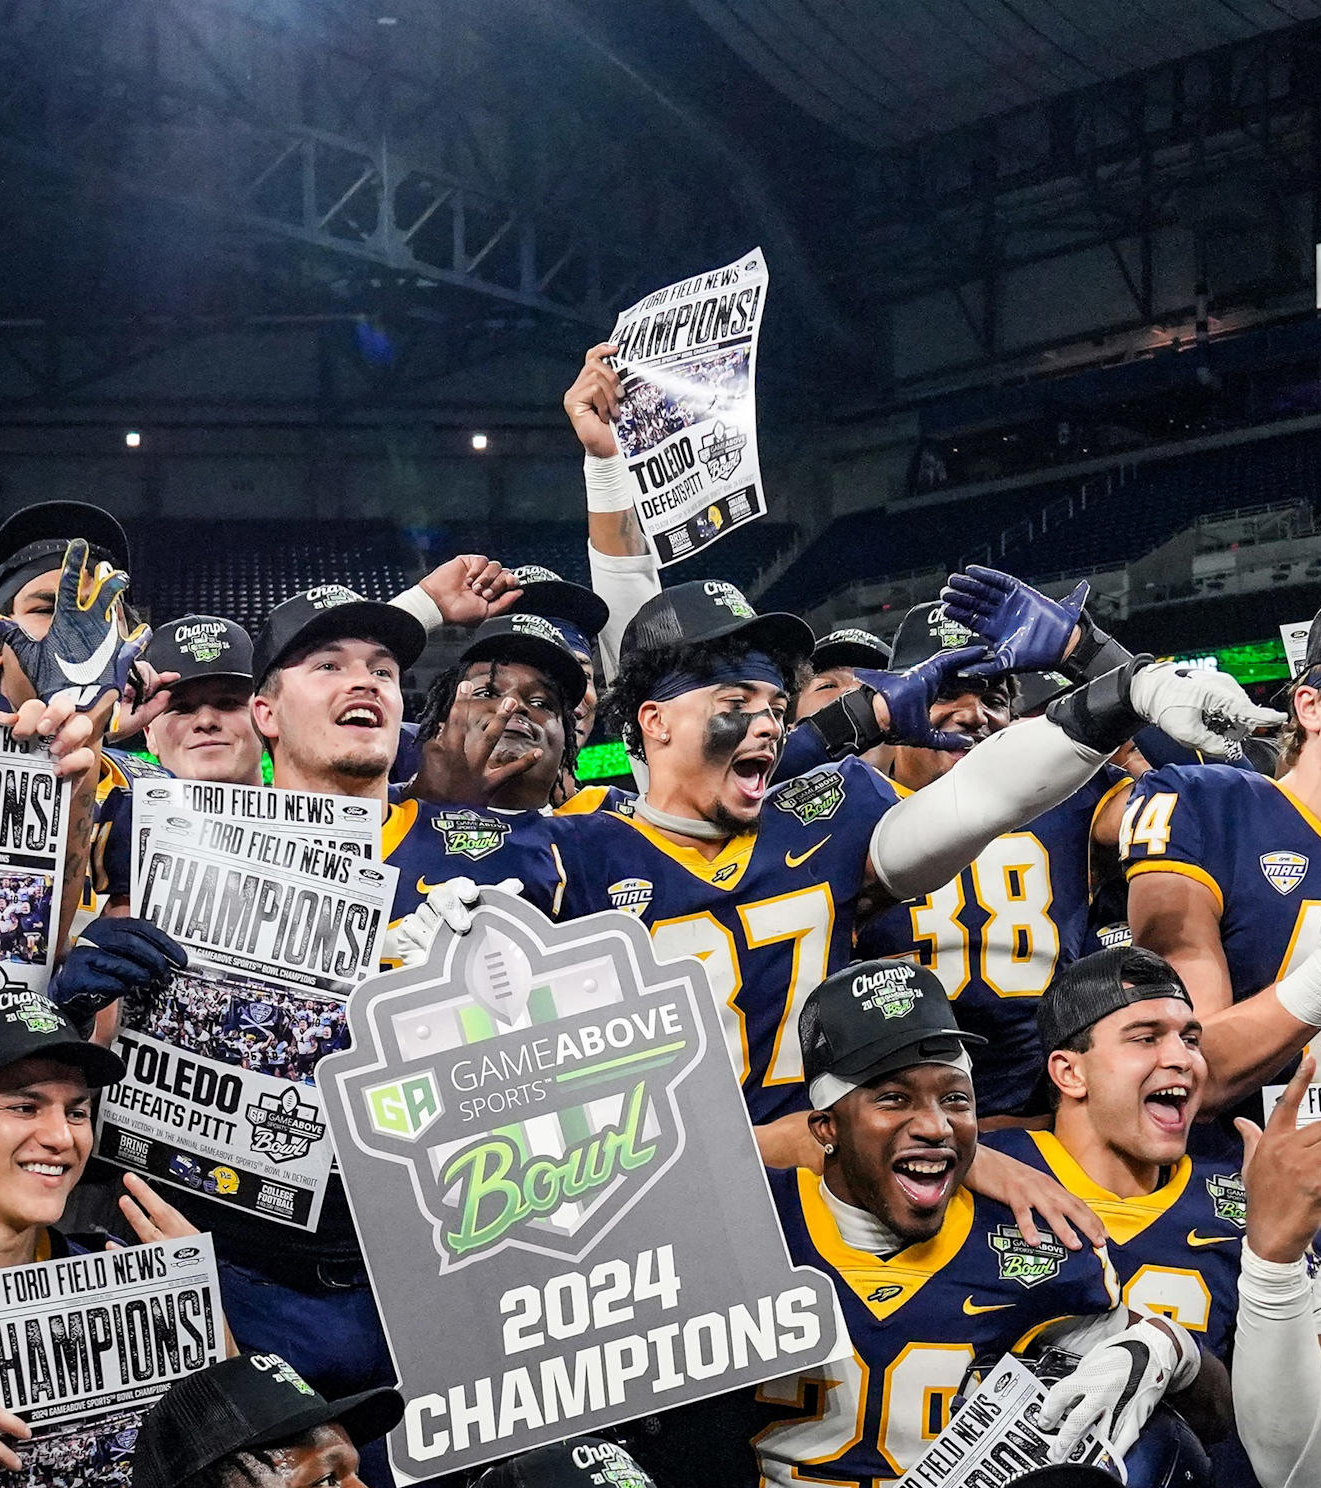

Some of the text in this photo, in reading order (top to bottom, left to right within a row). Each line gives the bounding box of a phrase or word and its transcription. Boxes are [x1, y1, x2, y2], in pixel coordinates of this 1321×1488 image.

[639, 265, 739, 313] FORD FIELD NEWS
[629, 436, 696, 495] TOLEDO
[642, 488, 683, 519] DEFEATS
[175, 624, 227, 642] Champs
[231, 788, 277, 820] FIELD
[284, 793, 334, 825] NEWS
[799, 788, 839, 819] Bowl
[199, 819, 245, 855] FORD
[247, 831, 297, 869] FIELD
[299, 844, 353, 884] NEWS
[449, 831, 498, 851] Bowl
[1266, 863, 1305, 878] MAC
[610, 889, 653, 907] MAC
[139, 852, 382, 982] CHAMPIONS!
[1100, 930, 1133, 947] MAC
[262, 963, 280, 976] BOWL
[280, 968, 317, 986] CHAMPIONS
[852, 966, 916, 998] Champs
[449, 1002, 684, 1094] GAMEABOVE
[116, 1037, 243, 1116] TOLEDO
[107, 1081, 186, 1128] DEFEATS
[268, 1111, 324, 1135] GAMEABOVE
[119, 1135, 149, 1155] BRING
[254, 1130, 309, 1158] Bowl
[291, 1171, 317, 1188] DETROIT
[443, 1080, 658, 1256] Bowl
[257, 1191, 294, 1211] FOOTBALL
[261, 1184, 295, 1201] COLLEGE
[1220, 1202, 1246, 1220] Bo
[2, 1246, 167, 1305] FORD FIELD NEWS
[1003, 1255, 1055, 1278] Bowl
[499, 1243, 682, 1356] 2024
[404, 1285, 822, 1463] CHAMPIONS
[31, 1409, 49, 1421] 2024
[49, 1401, 87, 1417] GAMEABOVE
[117, 1391, 135, 1403] BOWL
[135, 1382, 172, 1399] CHAMPIONS
[916, 1437, 965, 1488] FIELD
[951, 1393, 1002, 1448] NEWS
